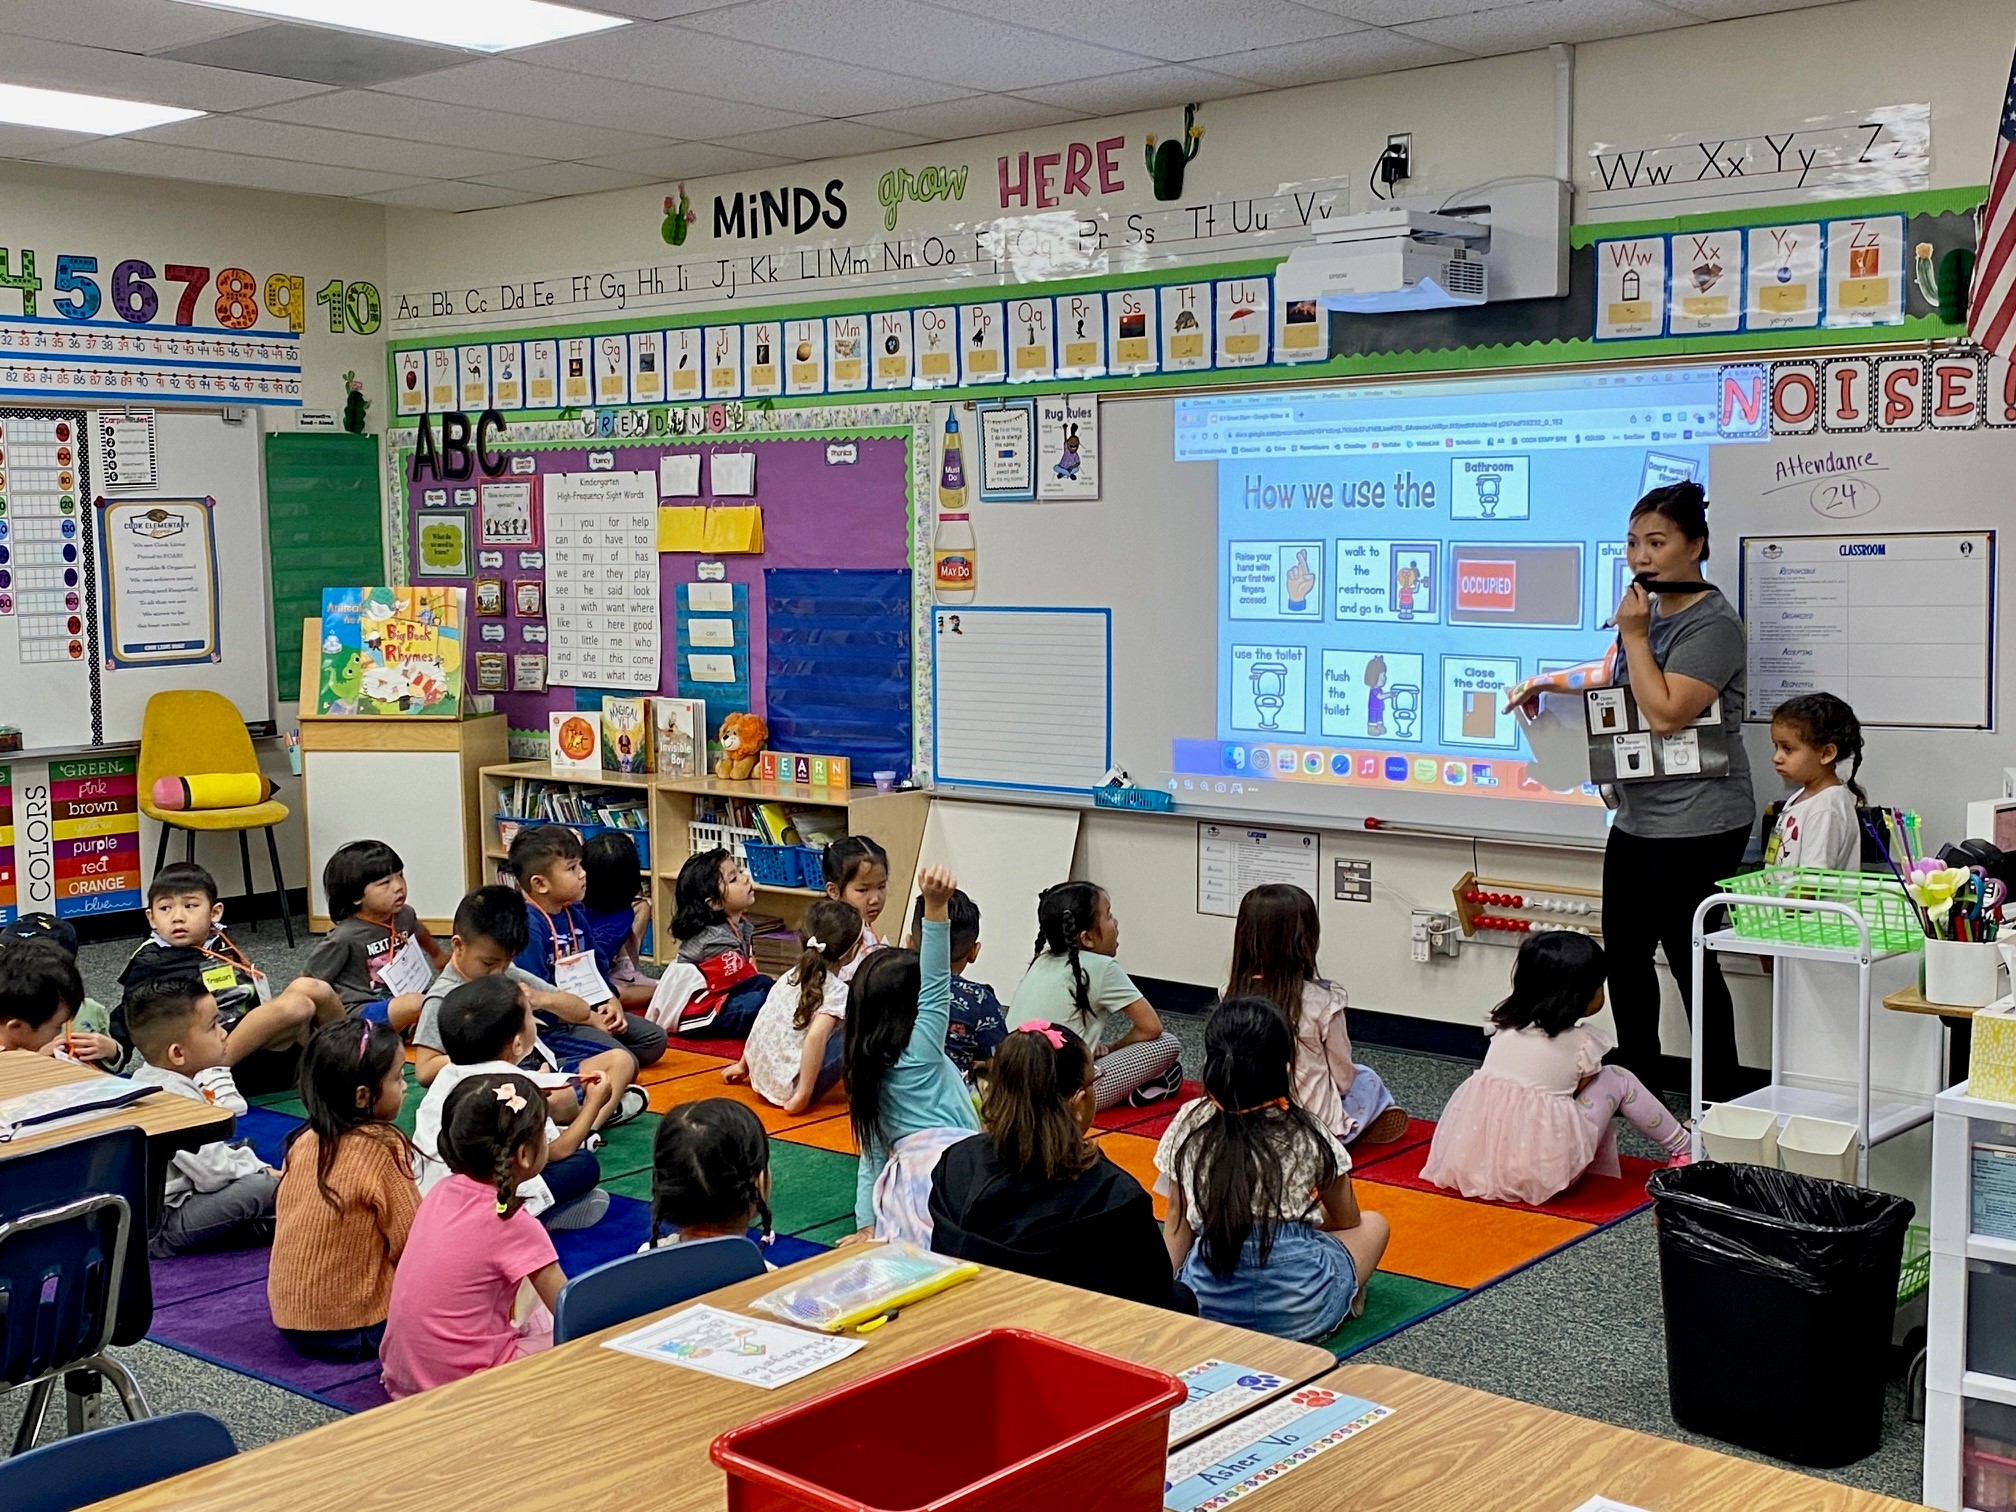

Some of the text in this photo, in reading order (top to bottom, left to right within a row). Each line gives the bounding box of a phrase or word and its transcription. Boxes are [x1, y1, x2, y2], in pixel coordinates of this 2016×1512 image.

[1596, 150, 1672, 190] Ww
[1697, 141, 1744, 180] Xx
[1765, 133, 1816, 188] Yy
[878, 164, 969, 231] grow
[997, 136, 1125, 209] HERE
[1610, 222, 1879, 268] Ww Xx Yy Zz
[398, 192, 1332, 319] Aa Bb Cc Dd Ee Ff Gg Hh Ii Jj Kk Ll Mm Nn Oo Ss Tt Uu Vv
[0, 248, 381, 335] 4 5 6 7 8 9 10
[1770, 316, 1794, 327] yo-yo
[1615, 325, 1643, 334] window
[153, 344, 298, 361] 41 42 43 44 45 46 47 48 49 50
[1045, 407, 1092, 421] Rug Rules
[412, 410, 508, 481] ABC
[945, 466, 961, 474] Must
[1464, 462, 1514, 473] Bathroom
[1775, 450, 1879, 482] Attendance
[580, 477, 620, 488] Kindergarten
[948, 474, 958, 482] Do
[606, 491, 622, 502] Sight
[624, 490, 644, 499] Words
[1245, 471, 1436, 510] How we use the
[1823, 483, 1857, 510] 24
[580, 519, 594, 530] you
[608, 517, 620, 527] for
[632, 517, 649, 530] help
[555, 534, 648, 544] can do have too
[555, 550, 568, 561] the
[582, 552, 594, 563] my
[610, 550, 620, 561] of
[635, 551, 649, 561] has
[1345, 546, 1380, 557] walk to
[1839, 544, 1886, 557] CLASSROOM
[1235, 553, 1272, 563] Raise your
[556, 568, 650, 580] we are they play
[1236, 563, 1270, 572] hand with
[1353, 564, 1370, 576] the
[1232, 575, 1247, 585] your
[1262, 574, 1276, 583] two
[1461, 576, 1512, 595] OCCUPIED
[555, 584, 650, 596] see he said look
[1241, 585, 1265, 595] fingers
[1338, 585, 1385, 596] restroom
[1239, 596, 1267, 604] crossed
[580, 601, 598, 612] with
[606, 602, 625, 613] want
[630, 602, 655, 613] where
[1339, 603, 1383, 616] and go in
[386, 623, 406, 645] Big
[384, 644, 434, 667] Rhymes
[1234, 648, 1303, 661] use the toilet
[1324, 669, 1350, 682] flush
[1464, 667, 1496, 680] Close
[1453, 677, 1505, 690] the door
[1328, 686, 1346, 699] the
[609, 704, 638, 722] MAGICAL
[1324, 703, 1350, 716] toilet
[660, 741, 692, 753] Invisible
[670, 753, 685, 768] Boy
[62, 761, 119, 777] GREEN
[79, 779, 107, 798] pink
[68, 801, 118, 816] brown
[25, 785, 50, 902] COLORS
[73, 837, 117, 856] purple
[81, 857, 108, 874] red
[69, 876, 125, 895] ORANGE
[367, 937, 390, 957] NEXT
[1198, 1434, 1300, 1486] Asher Vo
